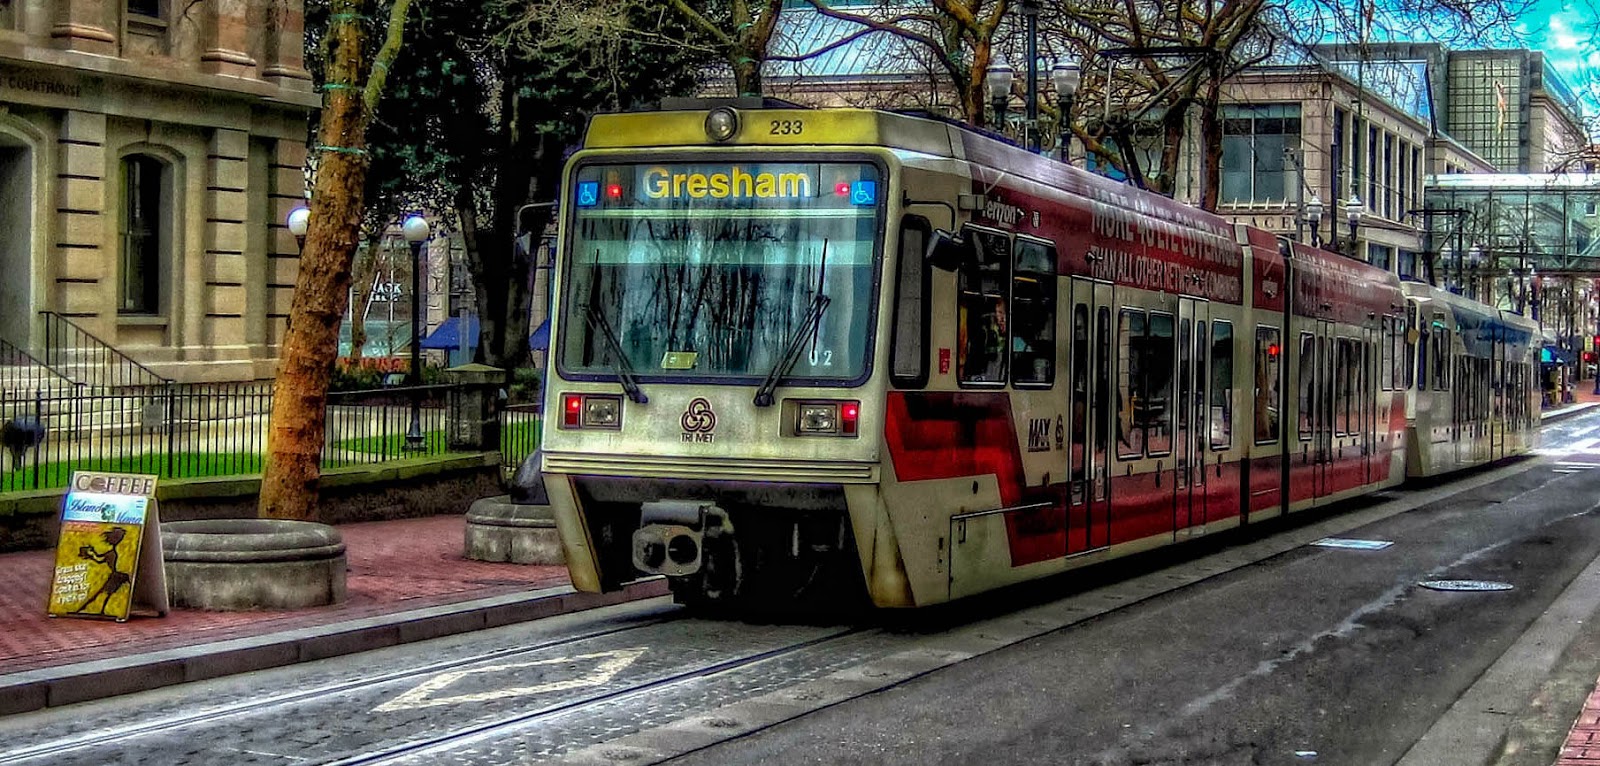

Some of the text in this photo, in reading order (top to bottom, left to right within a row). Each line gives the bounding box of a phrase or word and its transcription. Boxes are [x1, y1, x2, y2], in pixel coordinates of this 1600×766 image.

[769, 119, 803, 135] 233
[642, 166, 811, 199] Gresham
[981, 196, 1017, 226] erizon
[1028, 418, 1051, 447] MAX
[76, 474, 154, 495] COFFEE
[71, 498, 106, 513] Island
